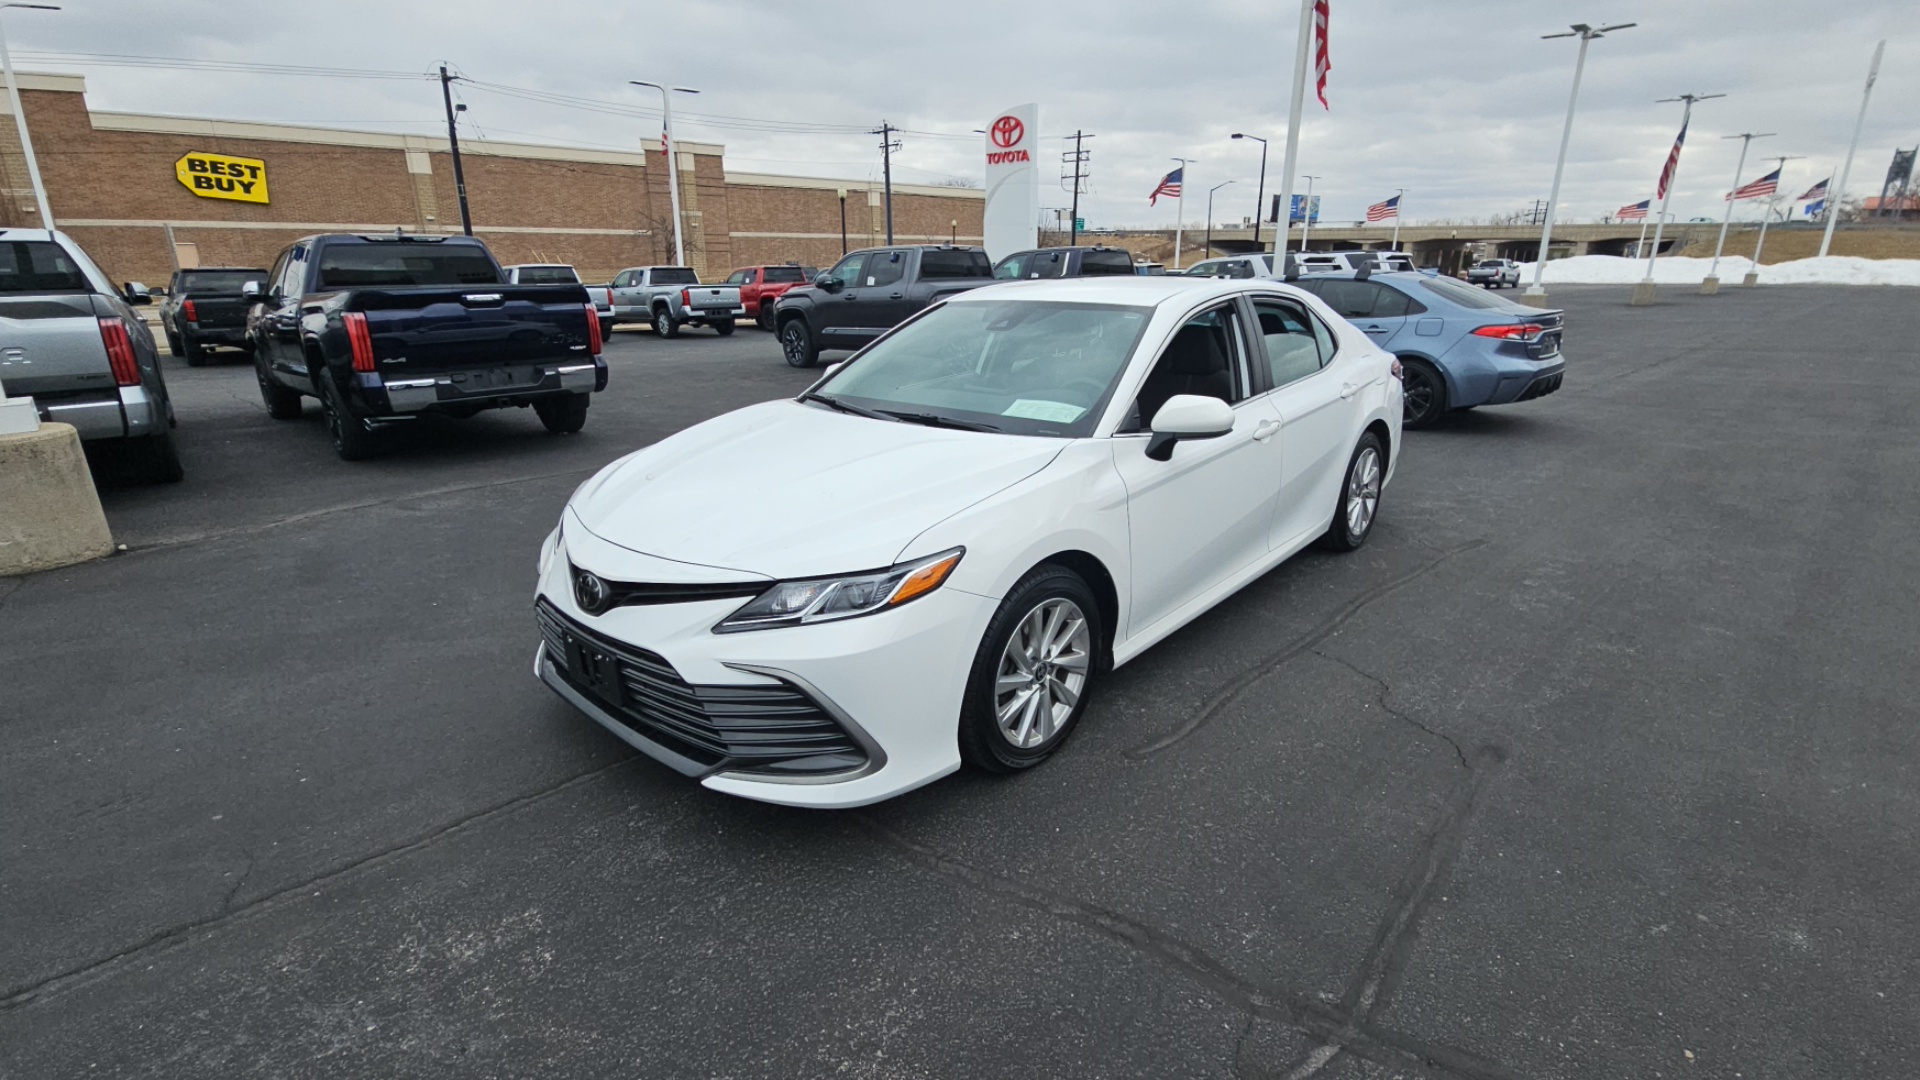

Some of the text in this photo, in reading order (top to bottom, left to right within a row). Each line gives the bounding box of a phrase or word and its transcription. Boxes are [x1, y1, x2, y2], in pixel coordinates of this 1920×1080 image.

[986, 149, 1030, 165] TOYOTA
[186, 157, 262, 180] BEST
[193, 174, 256, 195] BUY
